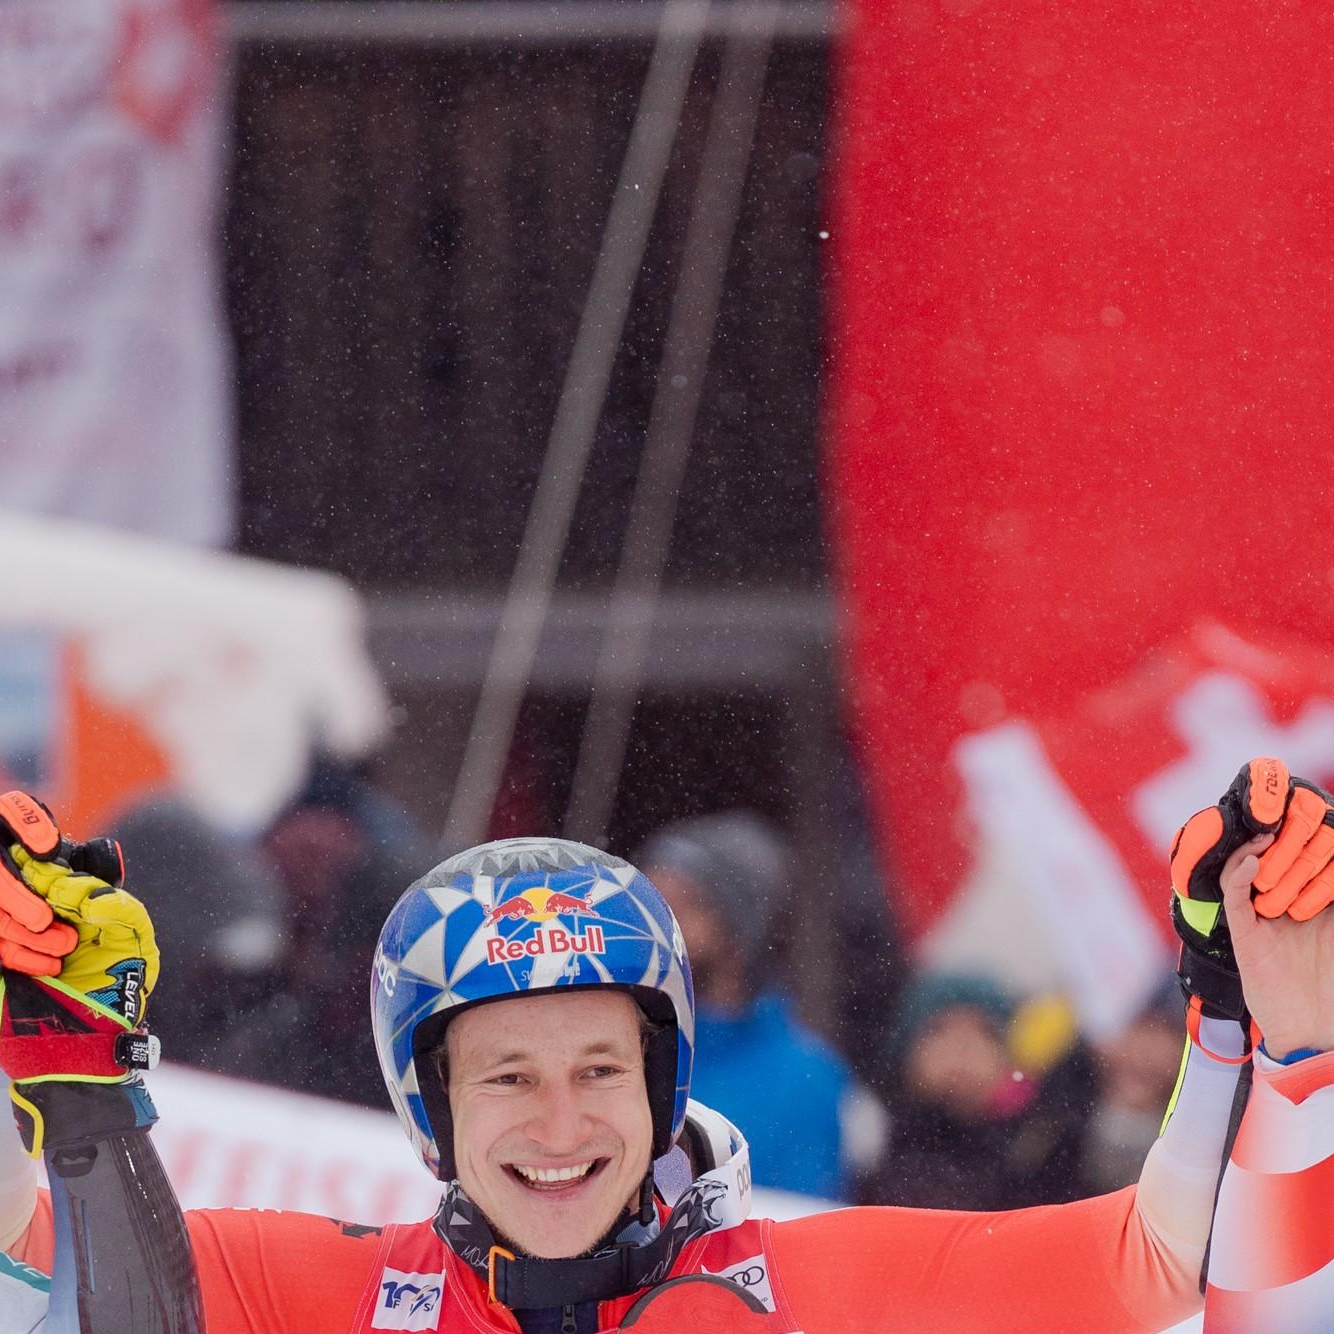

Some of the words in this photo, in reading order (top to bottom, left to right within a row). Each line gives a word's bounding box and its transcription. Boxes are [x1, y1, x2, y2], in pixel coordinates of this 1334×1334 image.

[486, 930, 545, 963] Red
[549, 927, 603, 953] Bull
[124, 970, 140, 1021] LEVEL
